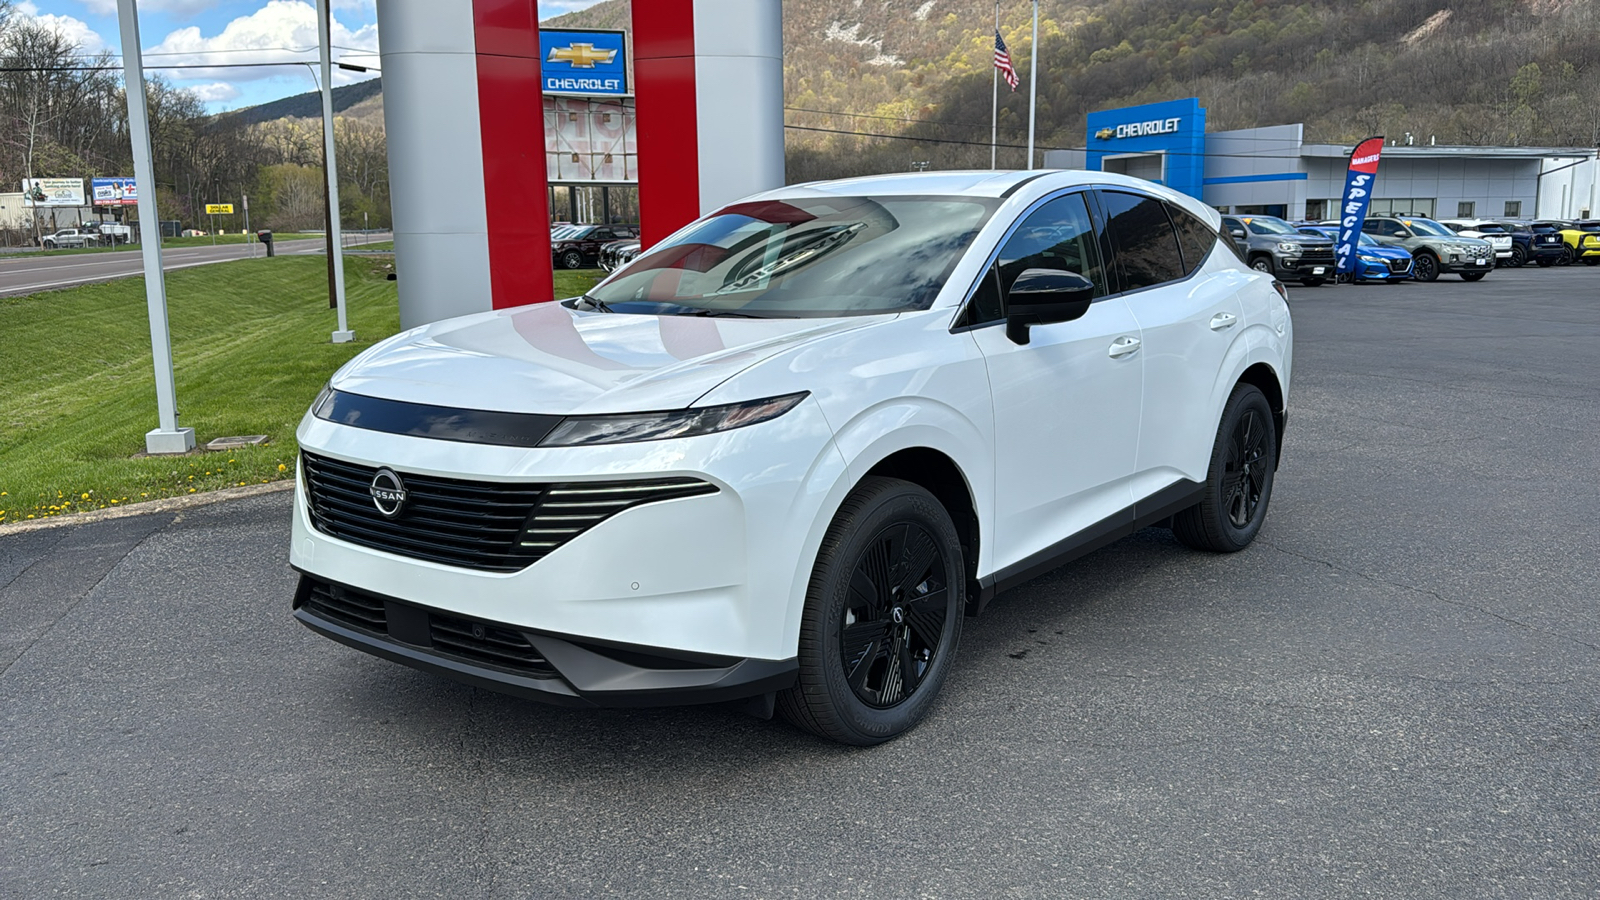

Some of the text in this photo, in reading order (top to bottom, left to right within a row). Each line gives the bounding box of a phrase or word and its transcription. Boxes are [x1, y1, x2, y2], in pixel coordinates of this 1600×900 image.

[547, 78, 620, 90] CHEVROLET
[1116, 117, 1181, 138] CHEVROLET
[1352, 153, 1380, 165] MANAGERS
[1338, 174, 1371, 269] SPECIAL
